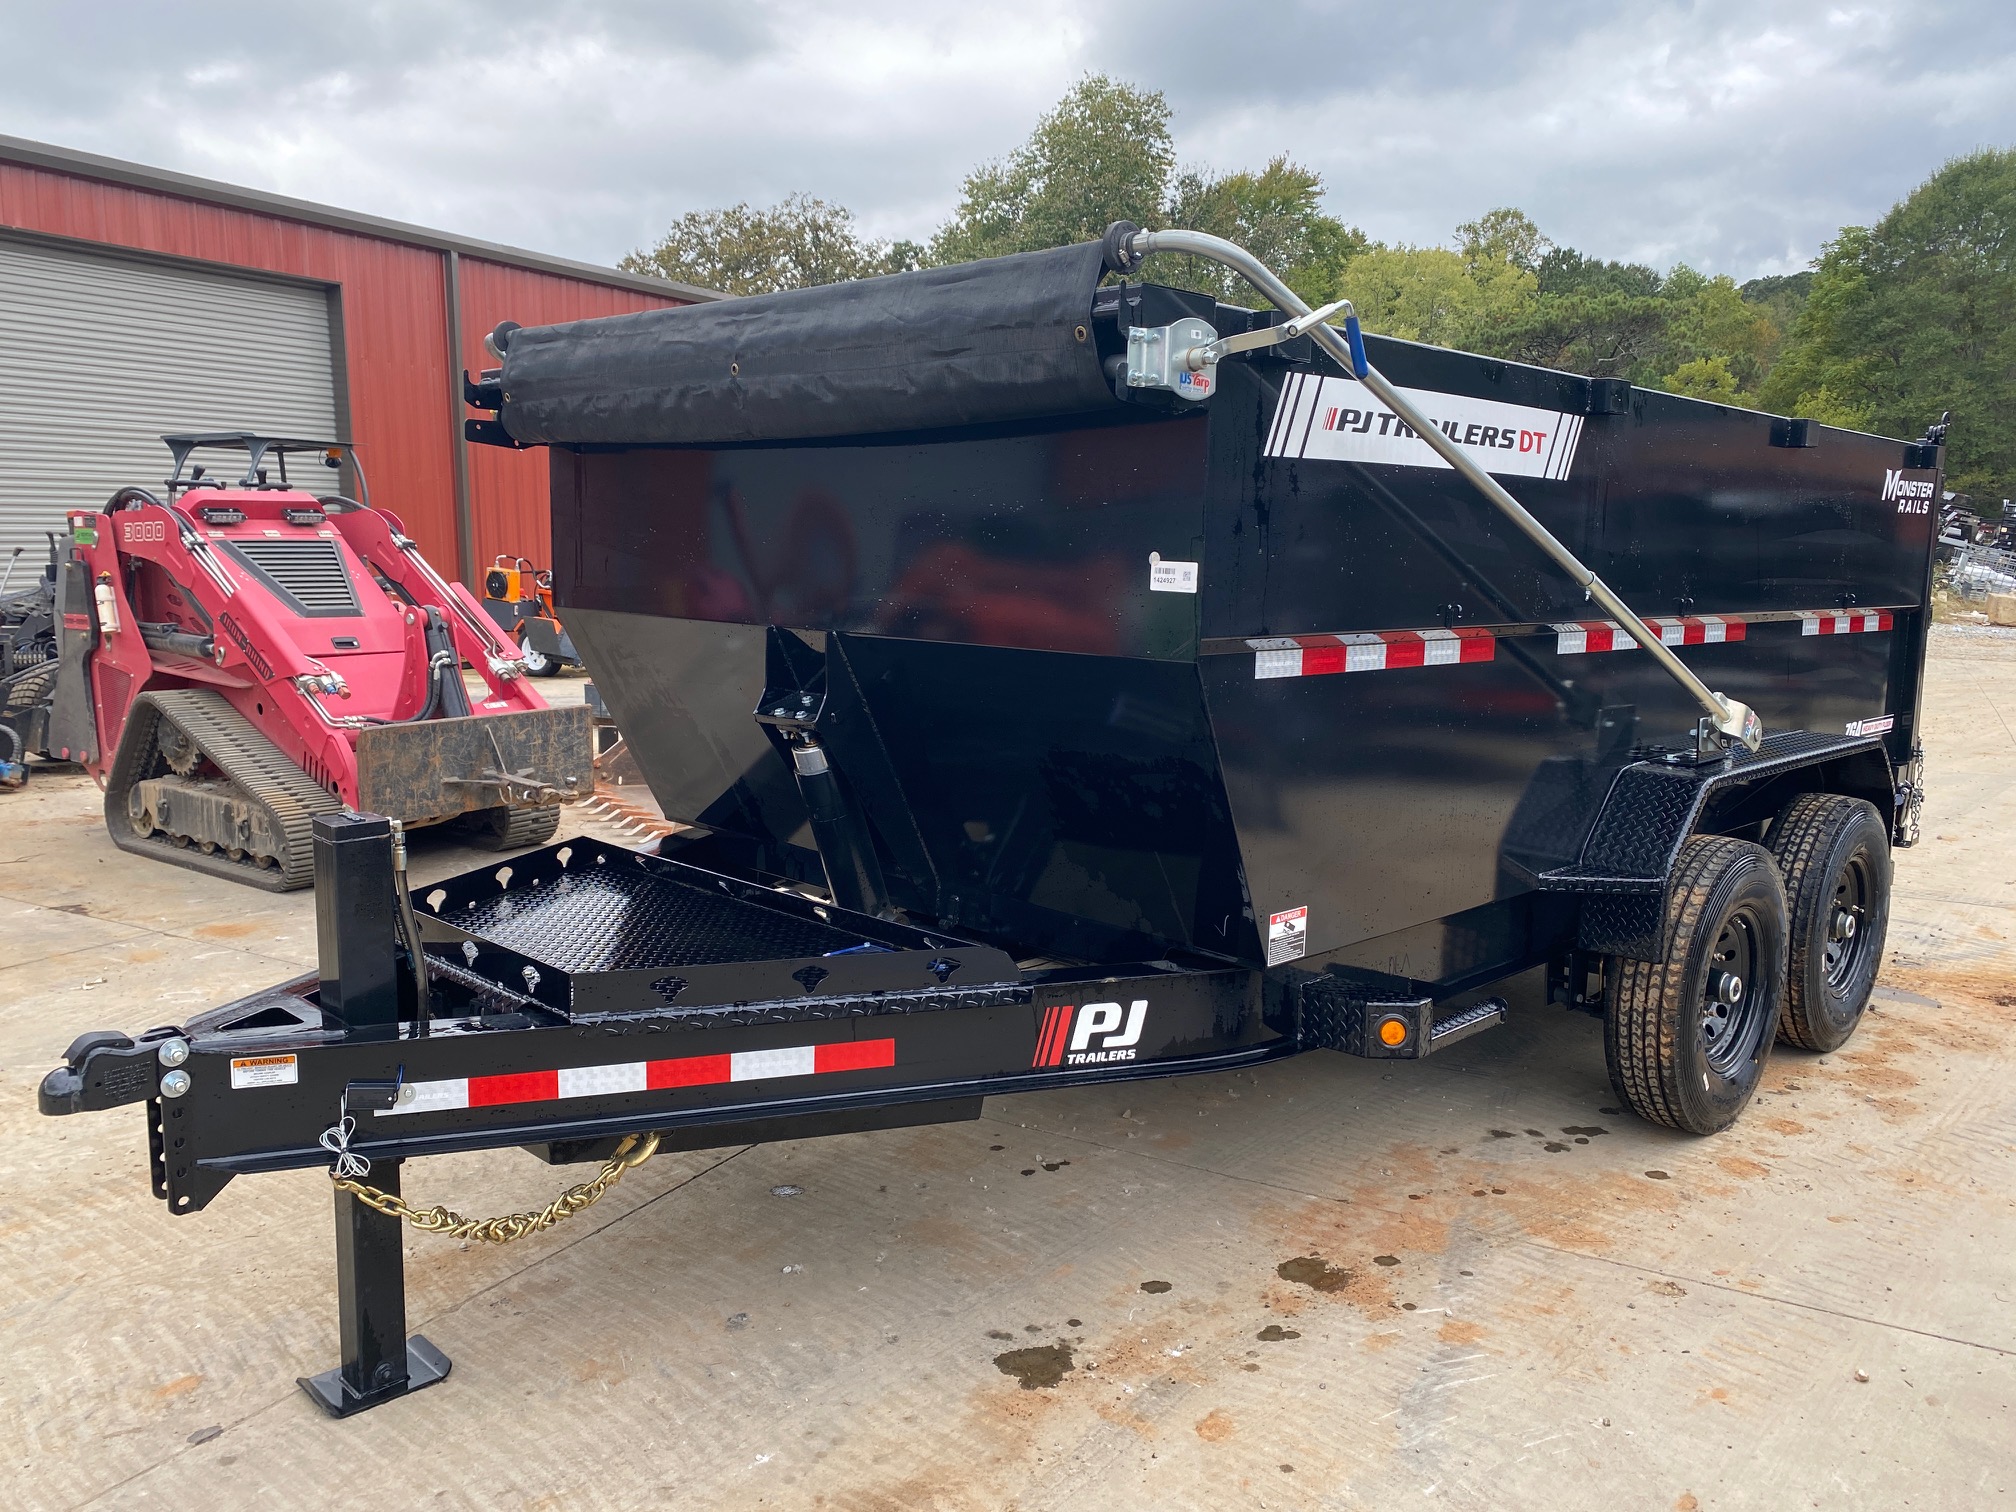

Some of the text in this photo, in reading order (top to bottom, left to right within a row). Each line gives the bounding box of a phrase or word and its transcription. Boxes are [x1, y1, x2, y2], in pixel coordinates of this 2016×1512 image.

[1180, 372, 1192, 385] US
[1336, 408, 1547, 455] PJ TRILERS DT
[1881, 468, 1935, 502] MONSTER
[1897, 498, 1930, 515] RAILS
[123, 521, 165, 542] 3000
[1280, 910, 1302, 922] DANGER
[1069, 999, 1149, 1051] PJ
[249, 1057, 289, 1066] WARNING
[1067, 1049, 1137, 1065] TRAILERS
